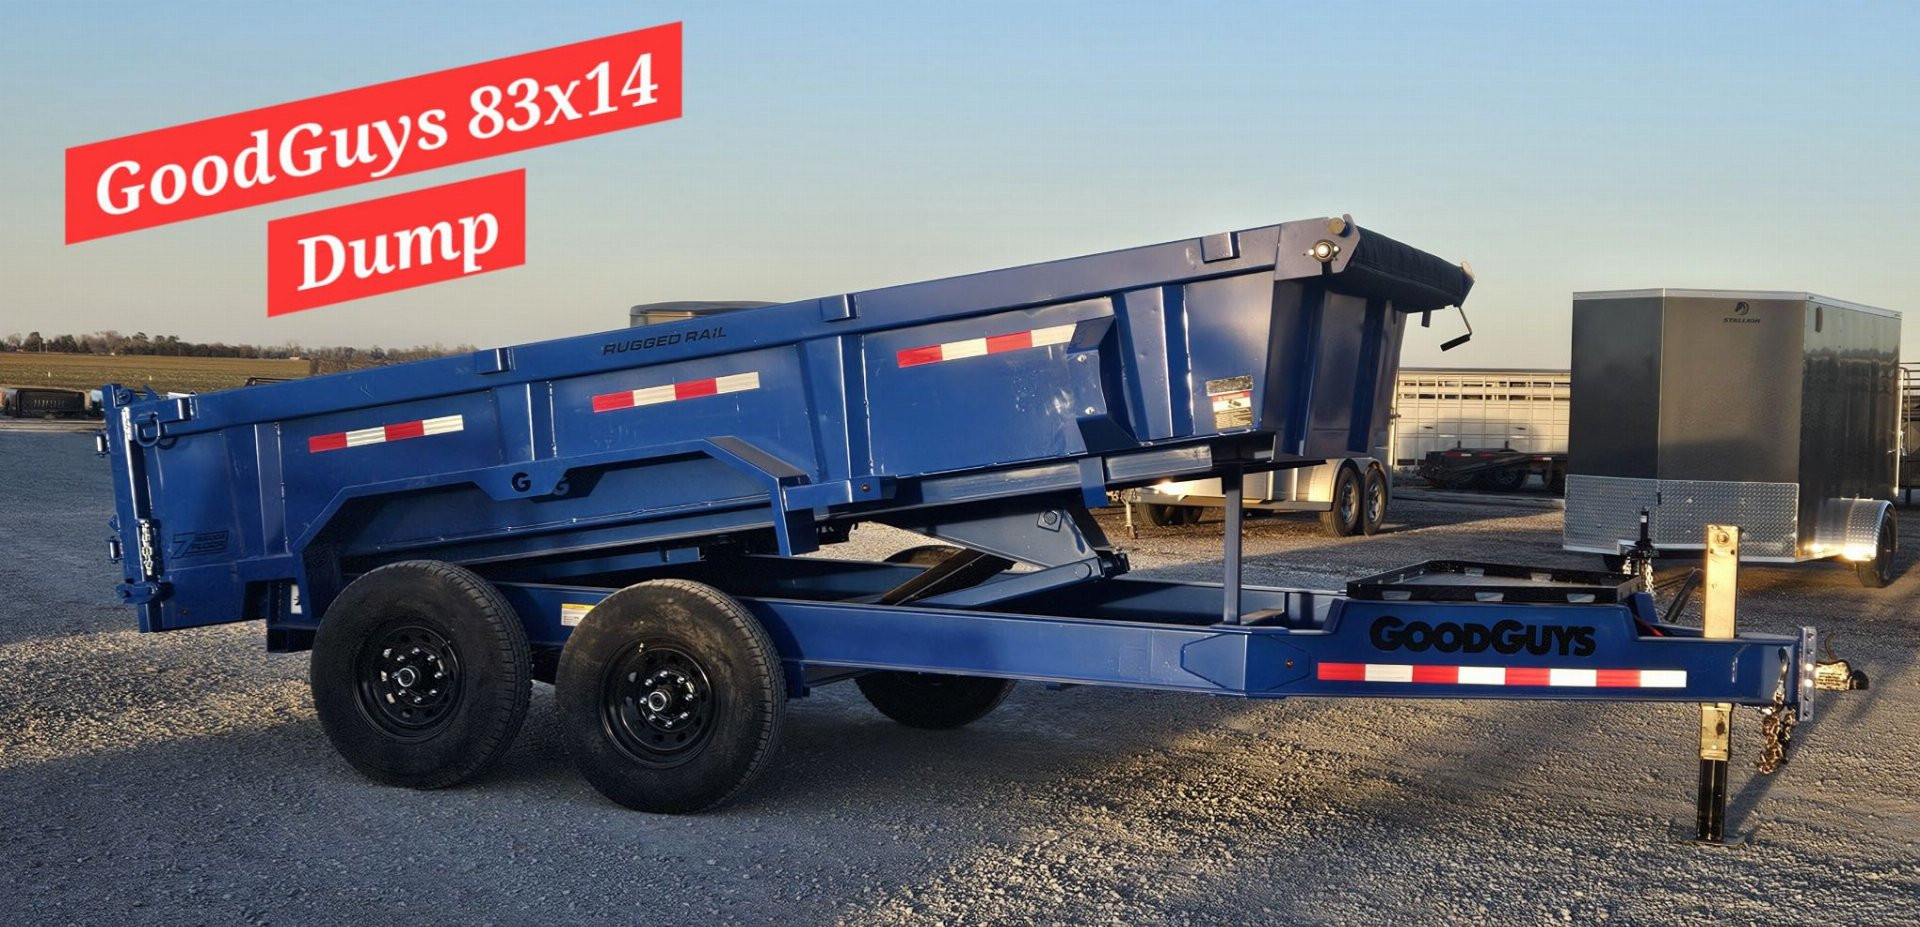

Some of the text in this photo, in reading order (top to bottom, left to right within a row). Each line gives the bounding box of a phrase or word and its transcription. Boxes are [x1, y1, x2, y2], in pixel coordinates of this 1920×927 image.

[603, 327, 727, 355] RUGGED RAIL
[511, 471, 531, 493] G
